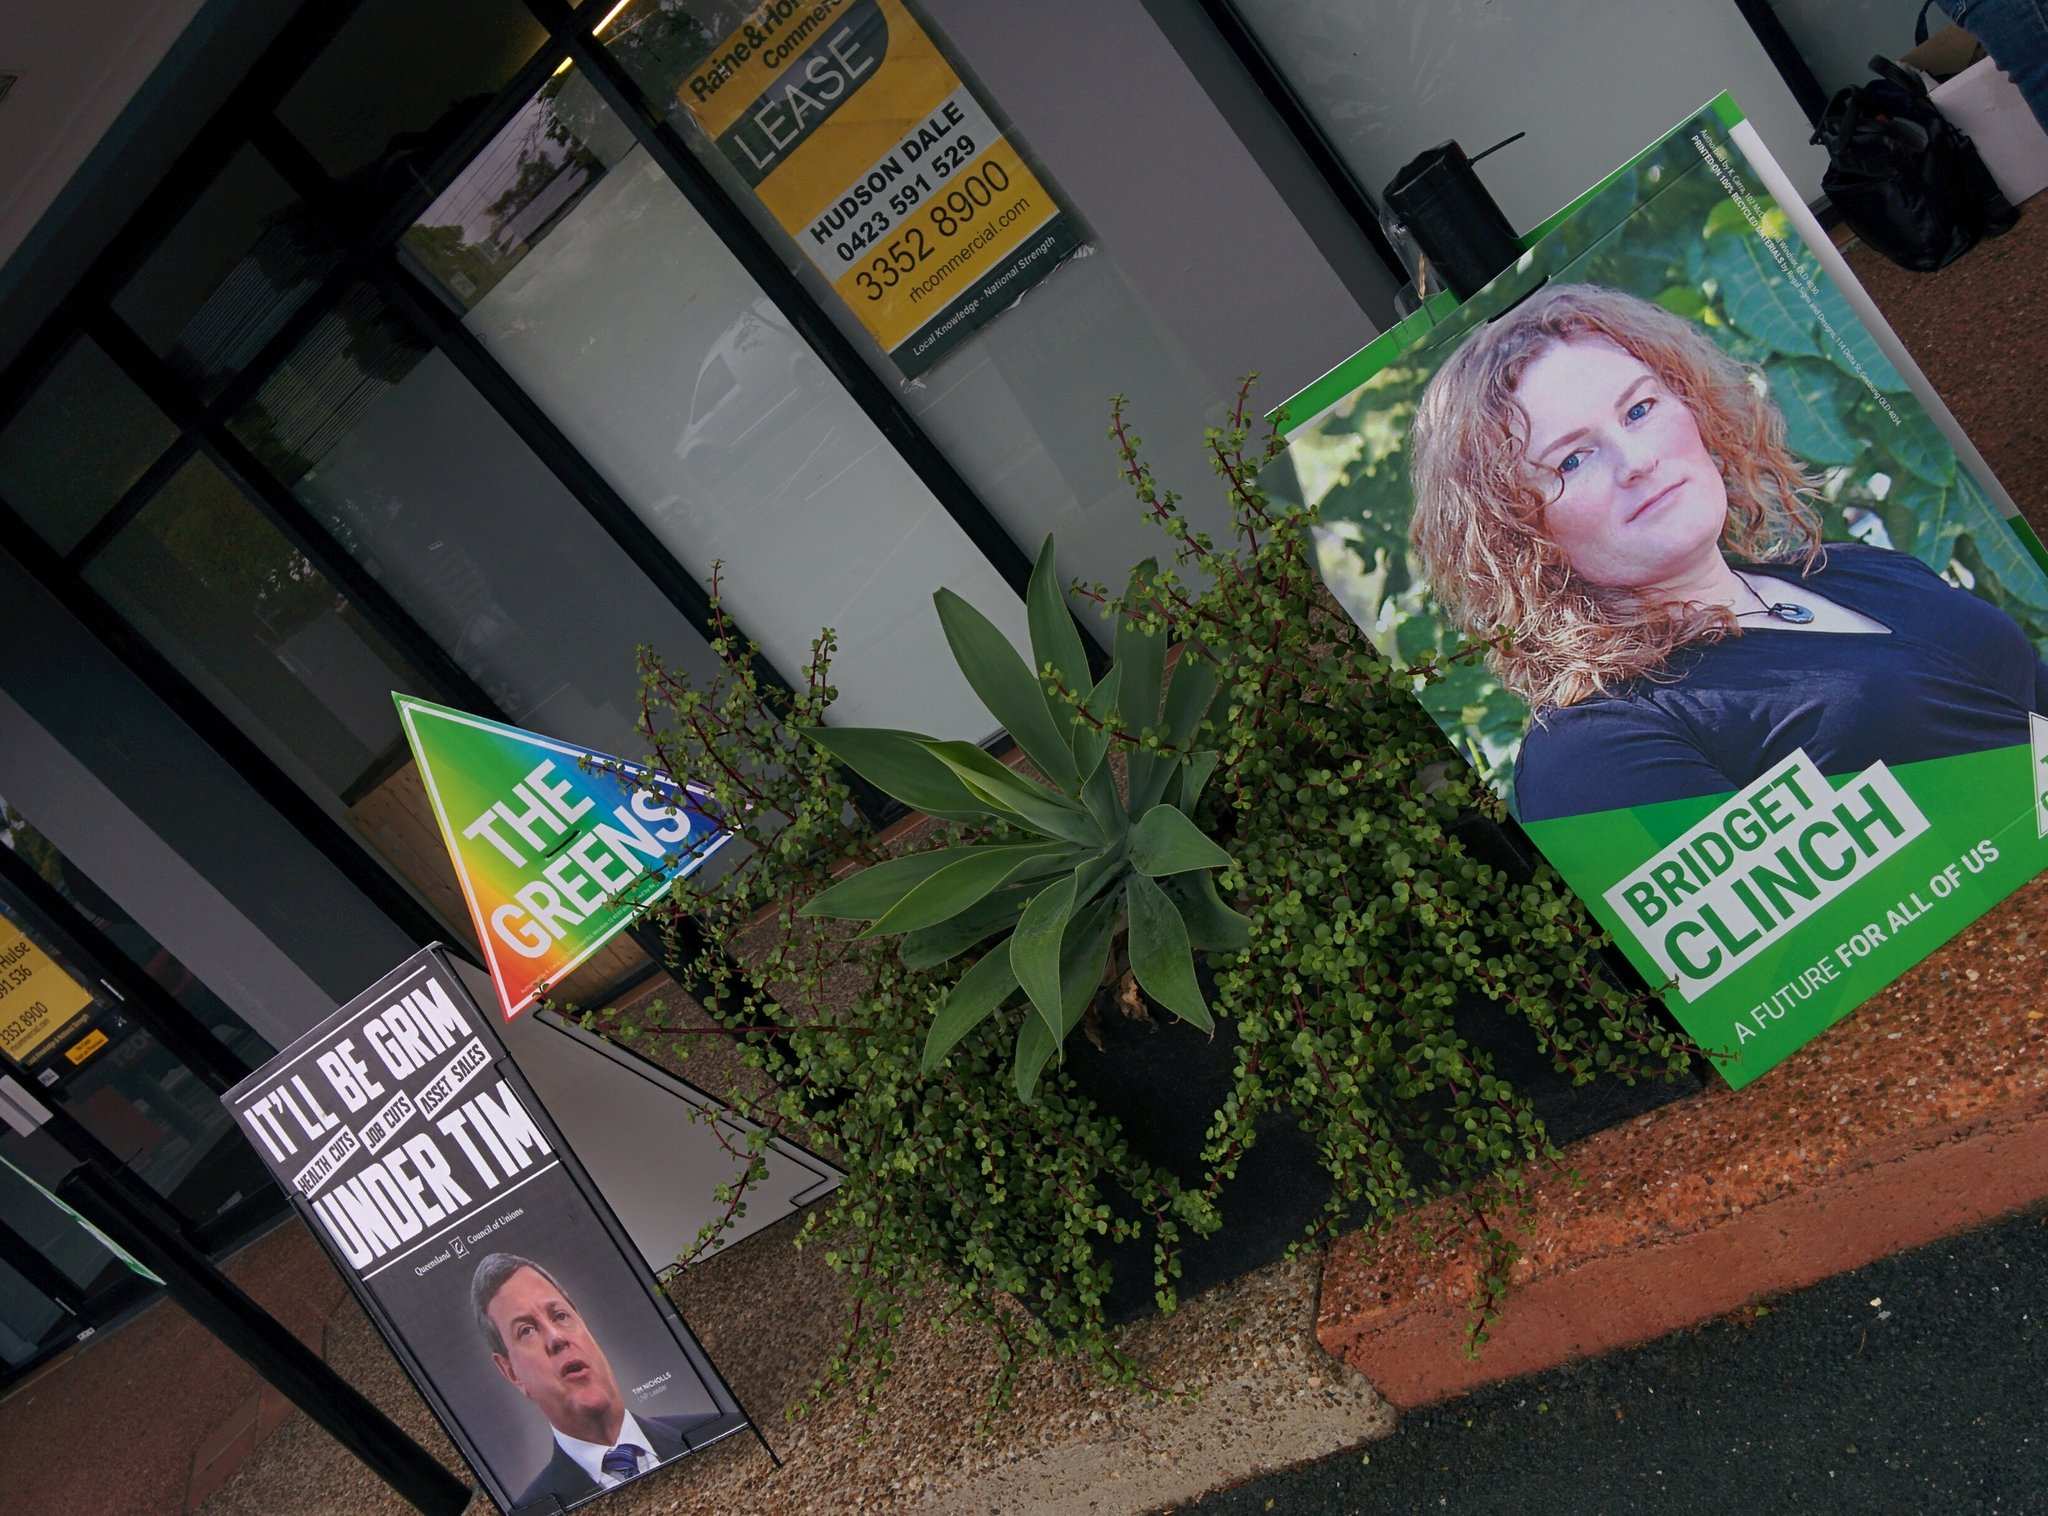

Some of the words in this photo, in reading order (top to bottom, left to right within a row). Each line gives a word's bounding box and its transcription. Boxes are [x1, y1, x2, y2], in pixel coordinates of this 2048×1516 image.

[734, 26, 874, 170] LEASE
[809, 156, 905, 245] HUDSON
[901, 100, 966, 164] DALE
[835, 210, 891, 263] 0423
[888, 173, 933, 216] 591
[931, 134, 977, 179] 529
[855, 227, 936, 301] 3352
[930, 160, 1010, 237] 8900
[1691, 134, 1715, 166] PRINTED
[1731, 191, 1759, 227] RECYCLED
[908, 196, 1031, 304] rhcommercial.com
[912, 335, 937, 356] Local
[934, 297, 980, 339] Knowledge
[983, 267, 1020, 298] National
[1017, 235, 1057, 271] Strength
[462, 758, 597, 869] THE
[490, 787, 692, 959] GREENS
[1622, 763, 1814, 928] BRIDGET
[1663, 783, 1907, 981] CLINCH
[1733, 1021, 1756, 1045] A
[1750, 956, 1843, 1030] FUTURE
[1834, 922, 1889, 969] FOR
[1885, 892, 1934, 935] ALL
[1929, 863, 1962, 899] OF
[1960, 838, 2000, 875] US
[19, 1001, 49, 1028] 8900
[243, 1074, 341, 1163] IT'LL
[316, 1038, 386, 1114] BE
[362, 976, 473, 1081] GRIM
[421, 1076, 453, 1115] ASSET
[451, 1043, 487, 1083] SALES
[298, 1153, 332, 1195] HEALTH
[330, 1131, 356, 1160] CUTS
[311, 1132, 473, 1270] UNDER
[436, 1079, 552, 1190] TIM
[365, 1121, 386, 1149] JOB
[384, 1097, 412, 1129] CUTS
[414, 1250, 451, 1277] Queensland
[466, 1224, 494, 1244] Council
[498, 1207, 525, 1226] Unions
